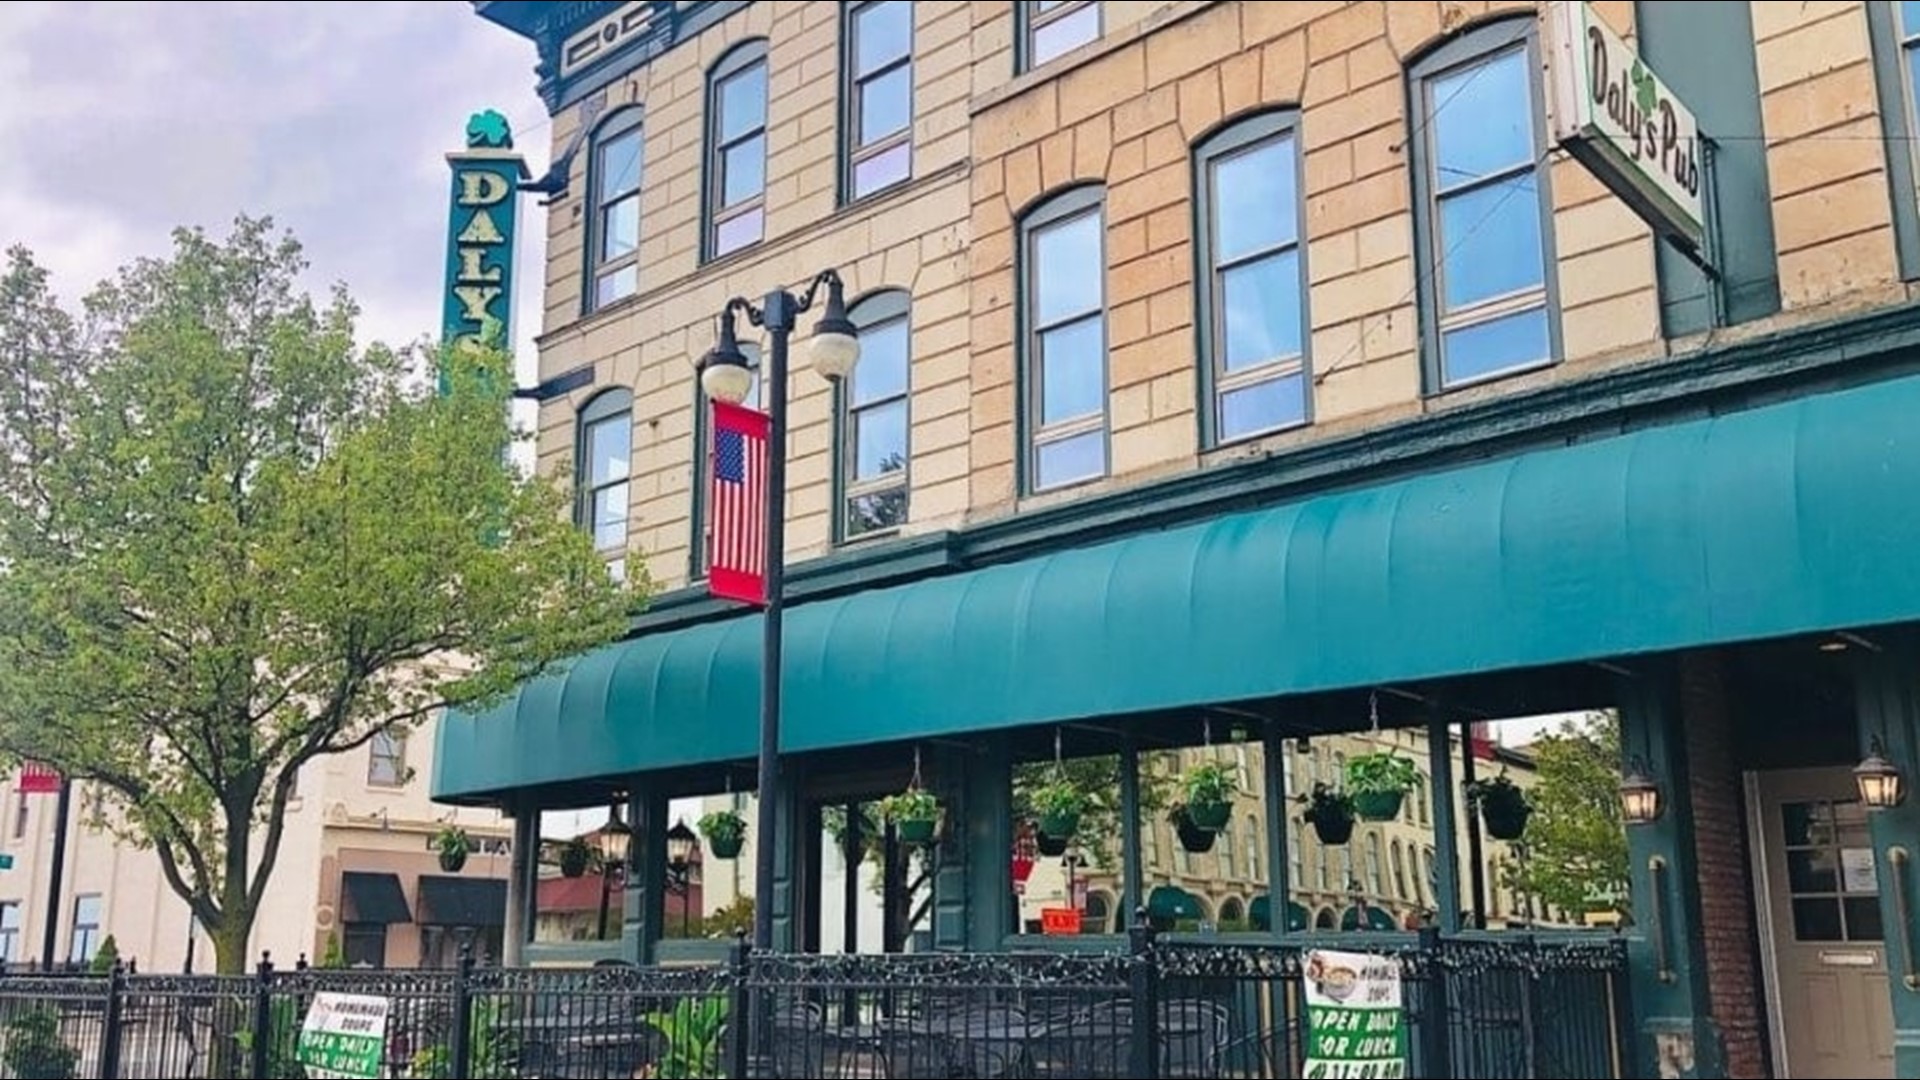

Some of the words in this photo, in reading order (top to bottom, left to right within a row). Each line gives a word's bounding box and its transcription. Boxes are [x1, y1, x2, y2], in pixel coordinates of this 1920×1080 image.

[1588, 25, 1658, 161] Daly's
[1659, 97, 1698, 198] Pub
[1311, 1009, 1362, 1032] OPEN
